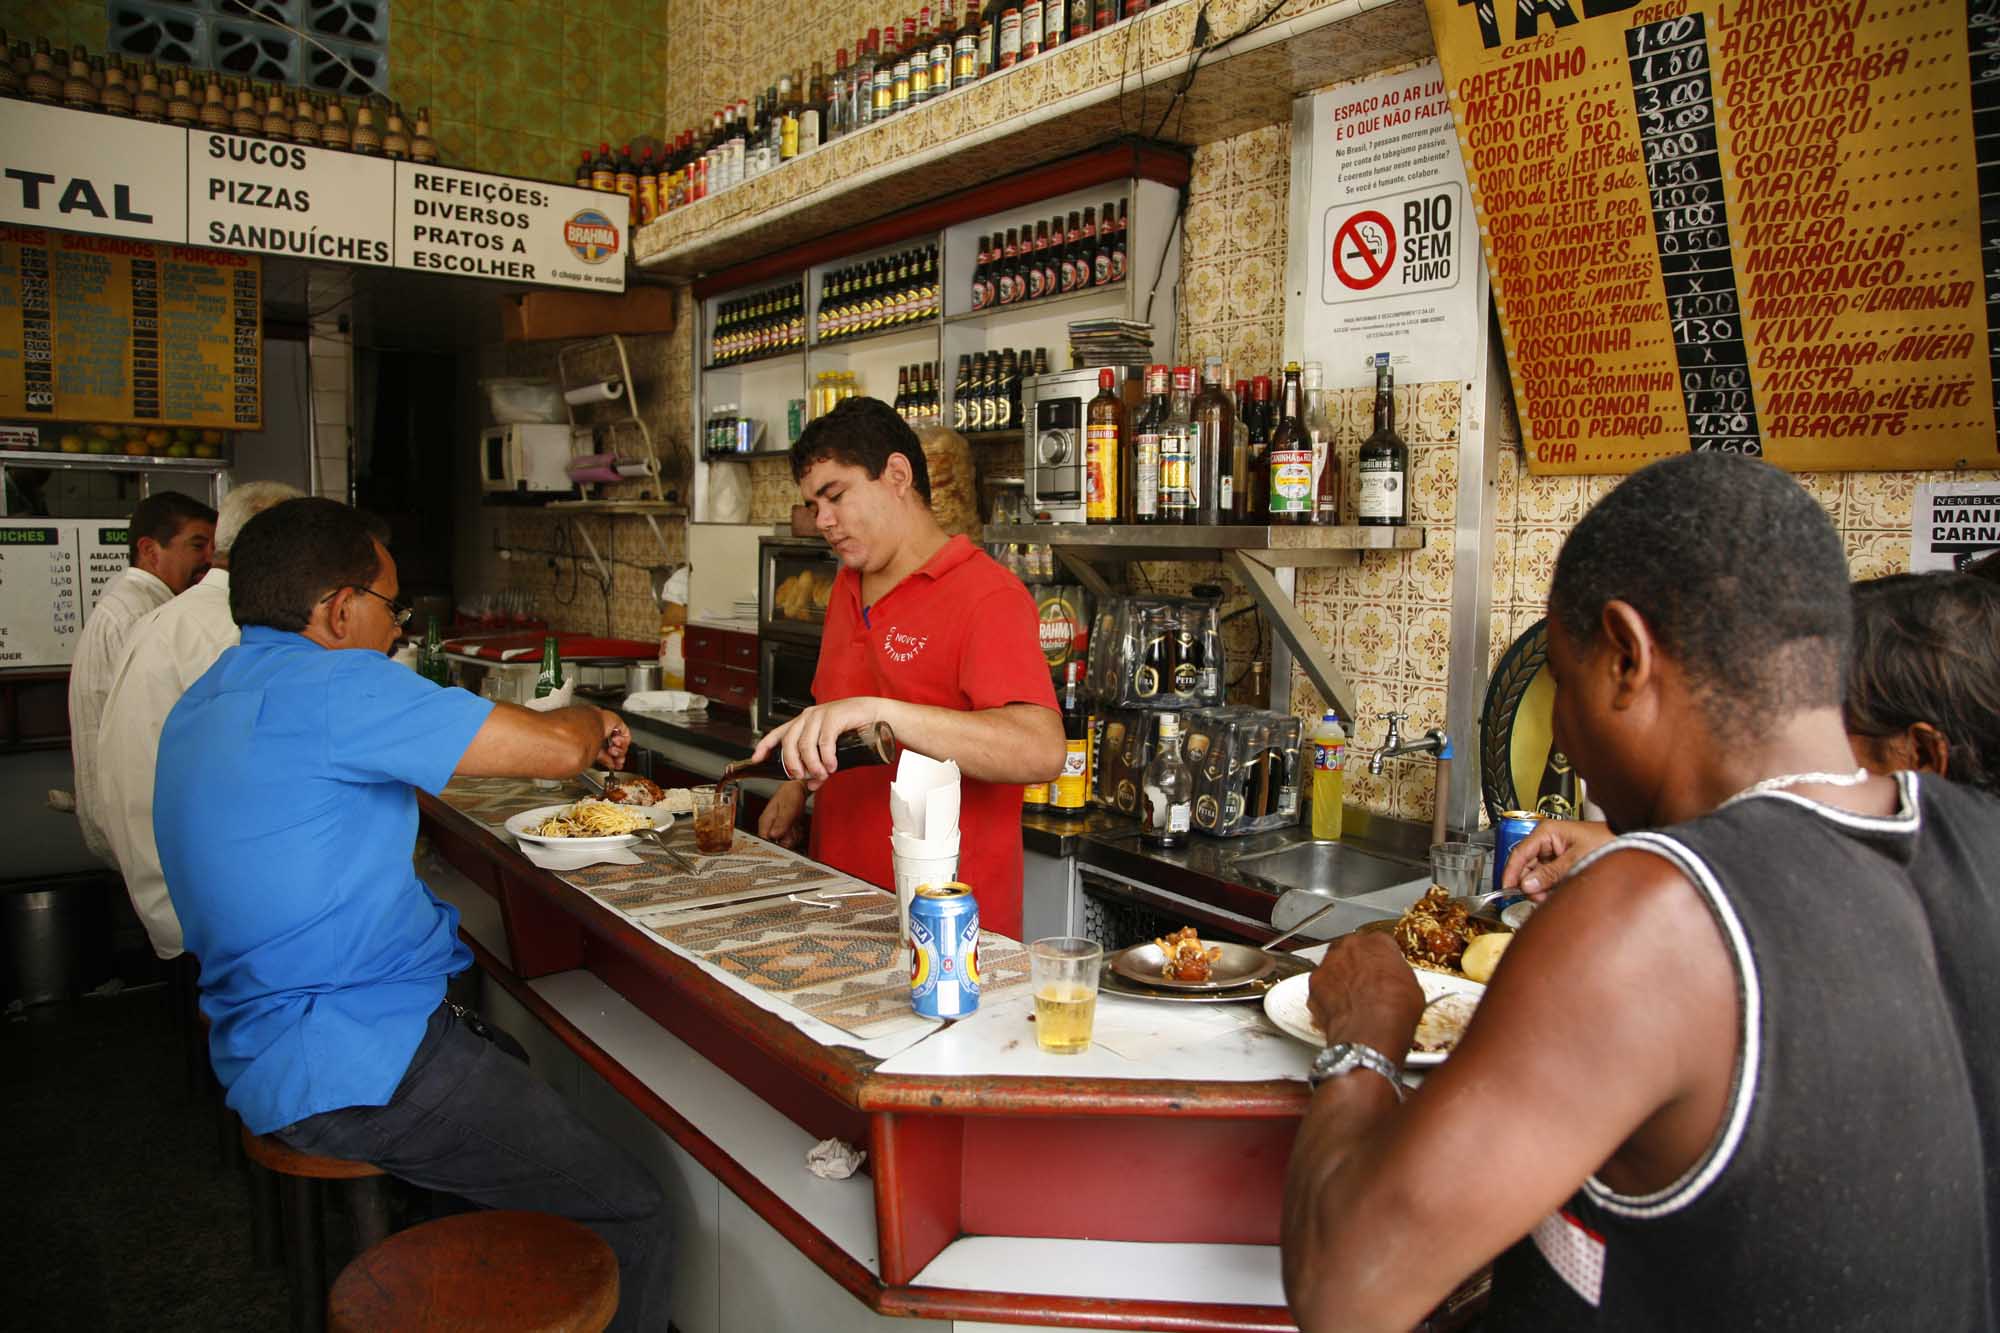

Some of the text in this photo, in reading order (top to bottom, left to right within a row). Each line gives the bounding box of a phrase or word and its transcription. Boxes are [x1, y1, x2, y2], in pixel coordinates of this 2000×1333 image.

[1720, 0, 1867, 58] ABACAXI
[1458, 46, 1586, 103] CAFEZINHO
[1721, 31, 1855, 86] ACEROLA
[1726, 48, 1909, 107] BETERRABA
[1334, 96, 1378, 122] ESPAÇO
[1382, 91, 1399, 109] AO
[1403, 86, 1421, 103] AR
[1728, 83, 1871, 131] CENOURA
[1347, 124, 1354, 139] O
[1358, 117, 1380, 136] QUE
[1383, 108, 1411, 129] NÃO
[1402, 128, 1428, 140] morrem
[1429, 125, 1442, 136] por
[1468, 115, 1514, 149] COPO
[1731, 106, 1872, 157] CUPUAÇU
[208, 135, 307, 171] SUCOS
[1473, 142, 1519, 171] COPO
[1735, 143, 1837, 179] GOIABA
[5, 168, 154, 224] TAL
[208, 178, 311, 214] PIZZAS
[414, 173, 550, 209] REFEIÇÕES:
[1478, 167, 1515, 196] COPO
[1483, 188, 1527, 215] COPO
[1550, 174, 1600, 206] LEITE
[414, 199, 530, 230] DIVERSOS
[1404, 194, 1452, 236] RIO
[1488, 213, 1532, 237] COPO
[1552, 199, 1600, 228] LEITE
[1740, 190, 1849, 226] MANGA
[62, 236, 155, 259] SALGADOS
[208, 221, 390, 263] SANDUÍCHES
[413, 225, 527, 254] PRATOS A
[567, 225, 615, 248] BRAHMA
[1404, 231, 1451, 264] SEM
[1744, 216, 1845, 249] MELÃO
[413, 251, 536, 280] ESCOLHER
[1403, 259, 1450, 285] FUMO
[1535, 240, 1631, 272] SIMPLES
[1535, 269, 1580, 294] DOCE
[1583, 260, 1653, 286] SIMPLES
[1749, 260, 1906, 299] MORANGO
[1537, 290, 1578, 315] DOCE
[1751, 292, 1848, 320] MAMÃO
[1510, 310, 1594, 339] TORRADA
[1754, 317, 1834, 346] KIWI
[1517, 328, 1631, 362] ROSQUINHA
[1758, 341, 1878, 370] BANANA
[1520, 357, 1595, 379] SONHO
[1761, 367, 1854, 392] MISTA
[1524, 378, 1570, 400] BOLO
[1587, 372, 1674, 396] FORMINHA
[1766, 386, 1875, 416] MAMÃO
[1528, 394, 1650, 420] BOLO CANOA
[1532, 415, 1662, 441] BOLO PEDAÇO
[1767, 412, 1909, 439] ABACATE
[1040, 622, 1074, 640] RAHMA
